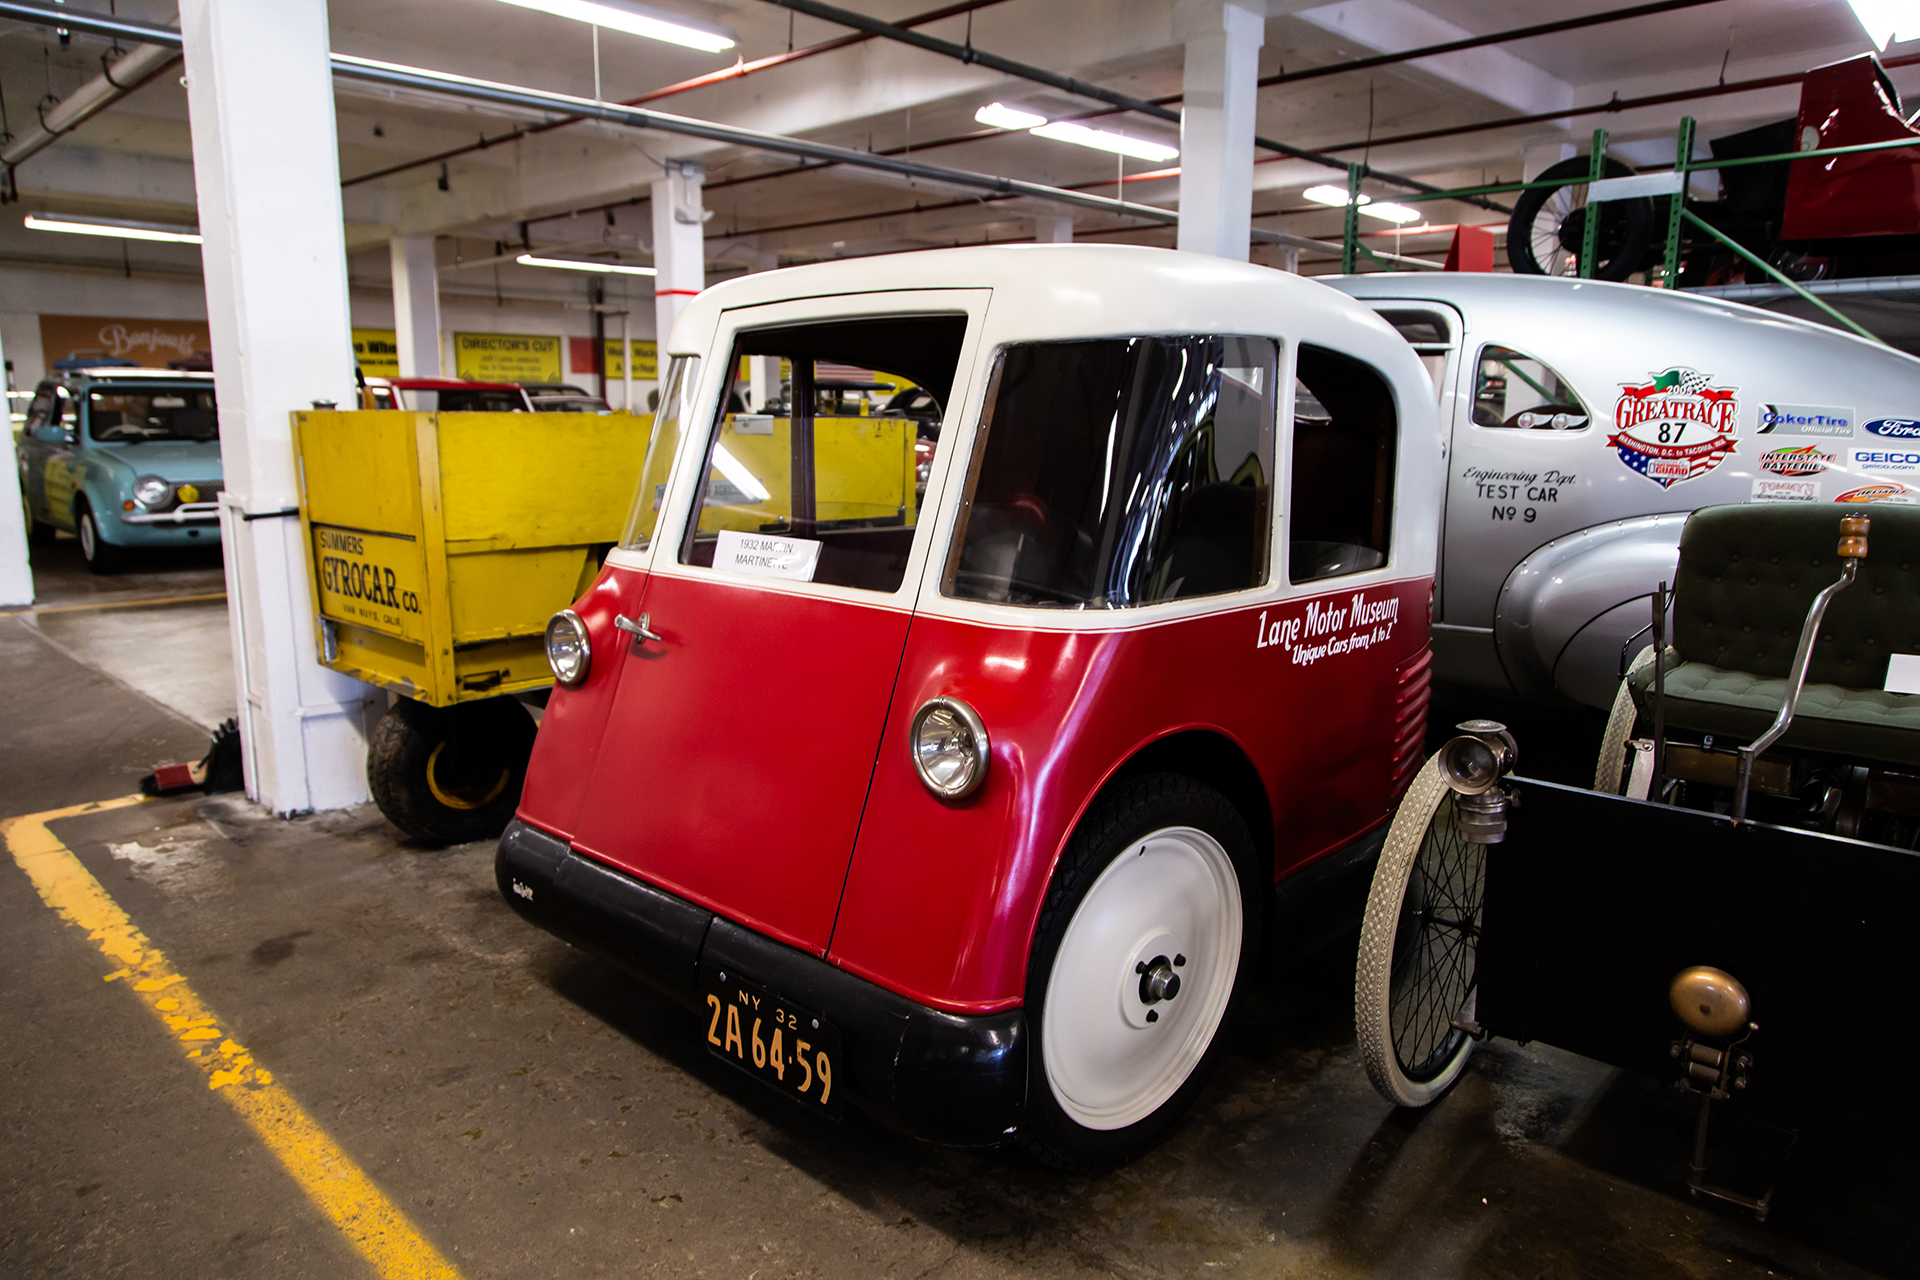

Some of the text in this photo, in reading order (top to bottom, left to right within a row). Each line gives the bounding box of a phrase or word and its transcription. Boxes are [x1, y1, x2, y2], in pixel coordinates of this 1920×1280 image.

[462, 337, 553, 352] DIRECTOR'S CUT
[1616, 397, 1736, 433] GREATRACE
[1657, 422, 1688, 444] 87
[1801, 425, 1852, 435] Official Tire
[1760, 453, 1834, 462] INTERSTATE
[1855, 451, 1920, 464] GEICO
[1655, 467, 1688, 476] GUARD
[1762, 462, 1827, 472] BATTERIES
[1463, 466, 1577, 487] Engineering Dept.
[1477, 484, 1558, 502] TEST CAR
[1524, 507, 1537, 523] 9
[320, 531, 363, 555] SUMMERS
[741, 539, 794, 553] 1932 MAIN
[323, 555, 422, 614] GYROCAR CO.
[343, 604, 356, 614] VAN
[1257, 593, 1399, 651] Lane Motor Museum
[1292, 622, 1393, 666] Unique Cars from A to Z
[776, 1008, 797, 1030] 32
